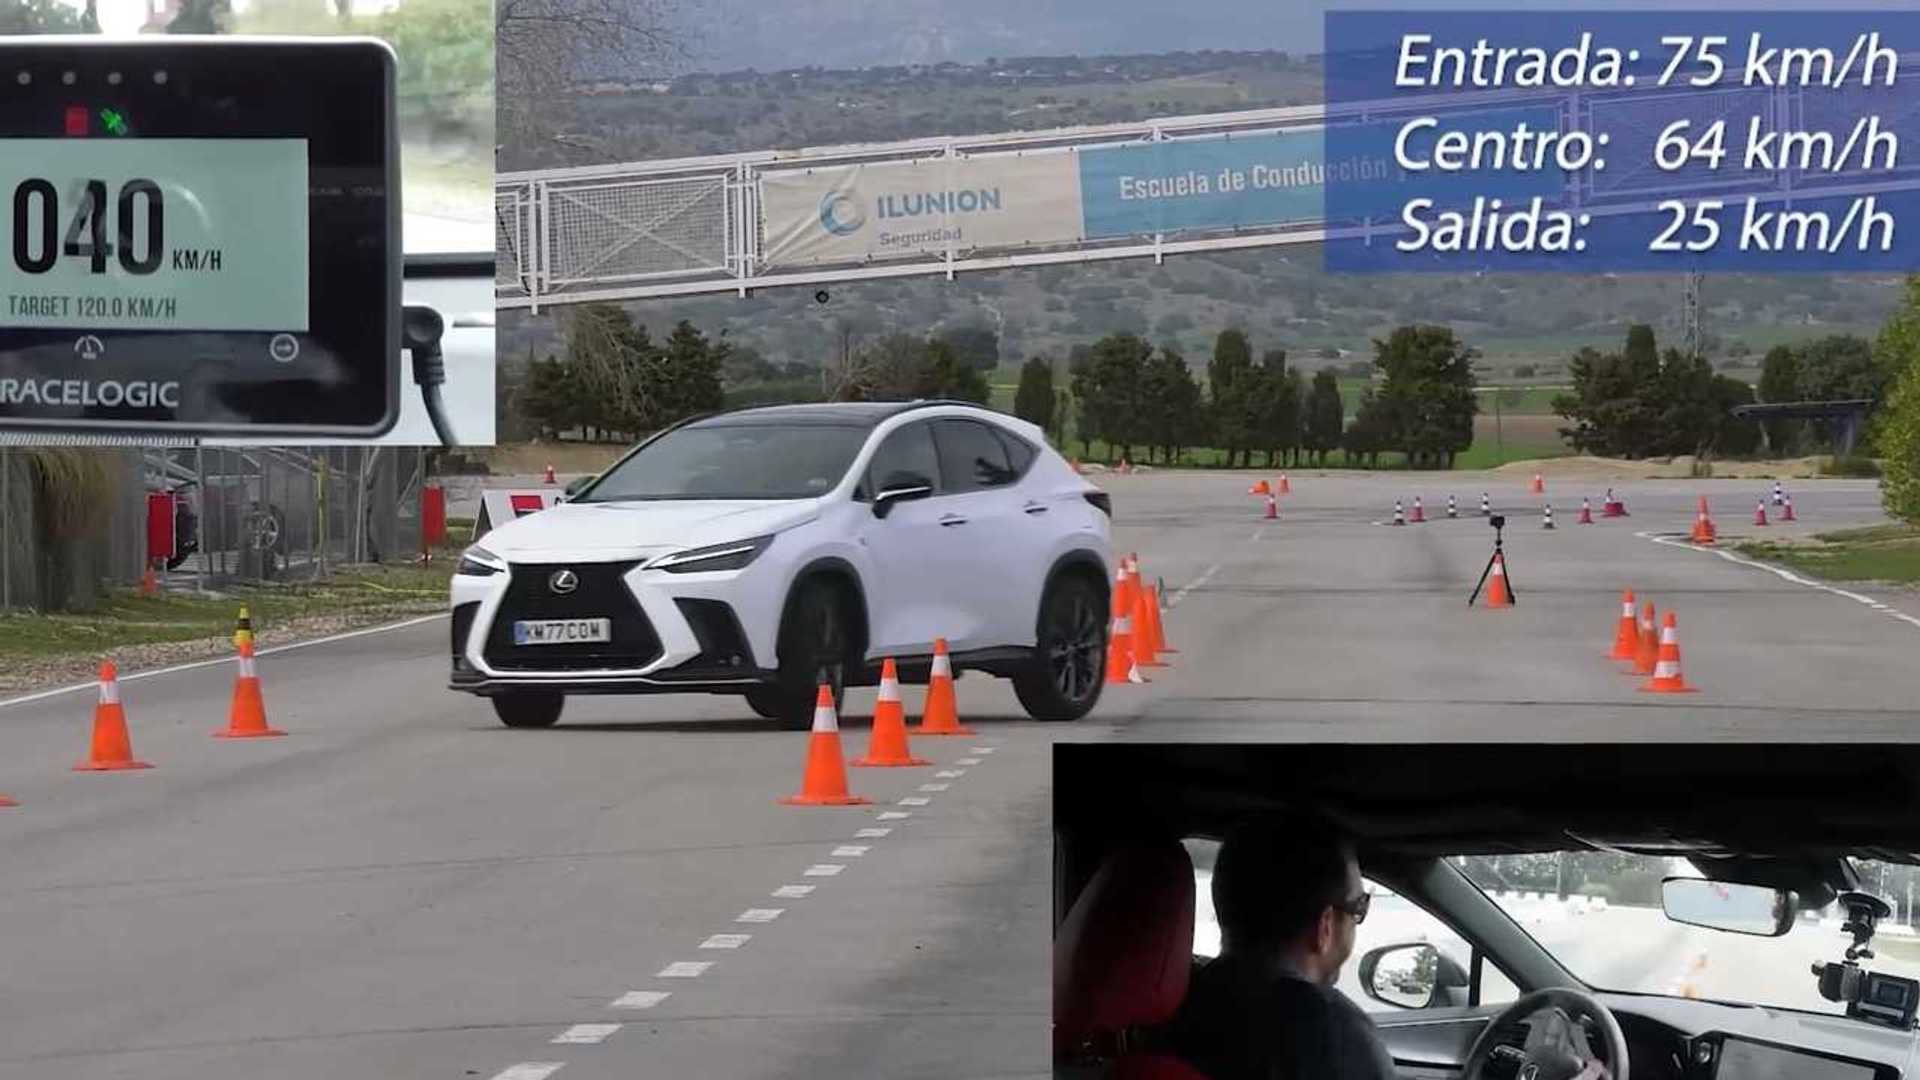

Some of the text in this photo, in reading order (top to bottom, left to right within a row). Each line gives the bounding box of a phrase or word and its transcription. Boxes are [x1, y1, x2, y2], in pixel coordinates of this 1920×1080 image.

[1119, 171, 1209, 200] Escuela
[1217, 168, 1246, 193] de
[1253, 155, 1388, 190] Conducción
[877, 188, 1001, 219] ILUNION
[13, 178, 222, 275] 040 KM/H
[879, 228, 962, 248] Seguridad
[9, 296, 177, 319] TARGET 120.0 KM/H
[0, 378, 180, 408] RACELOGIC
